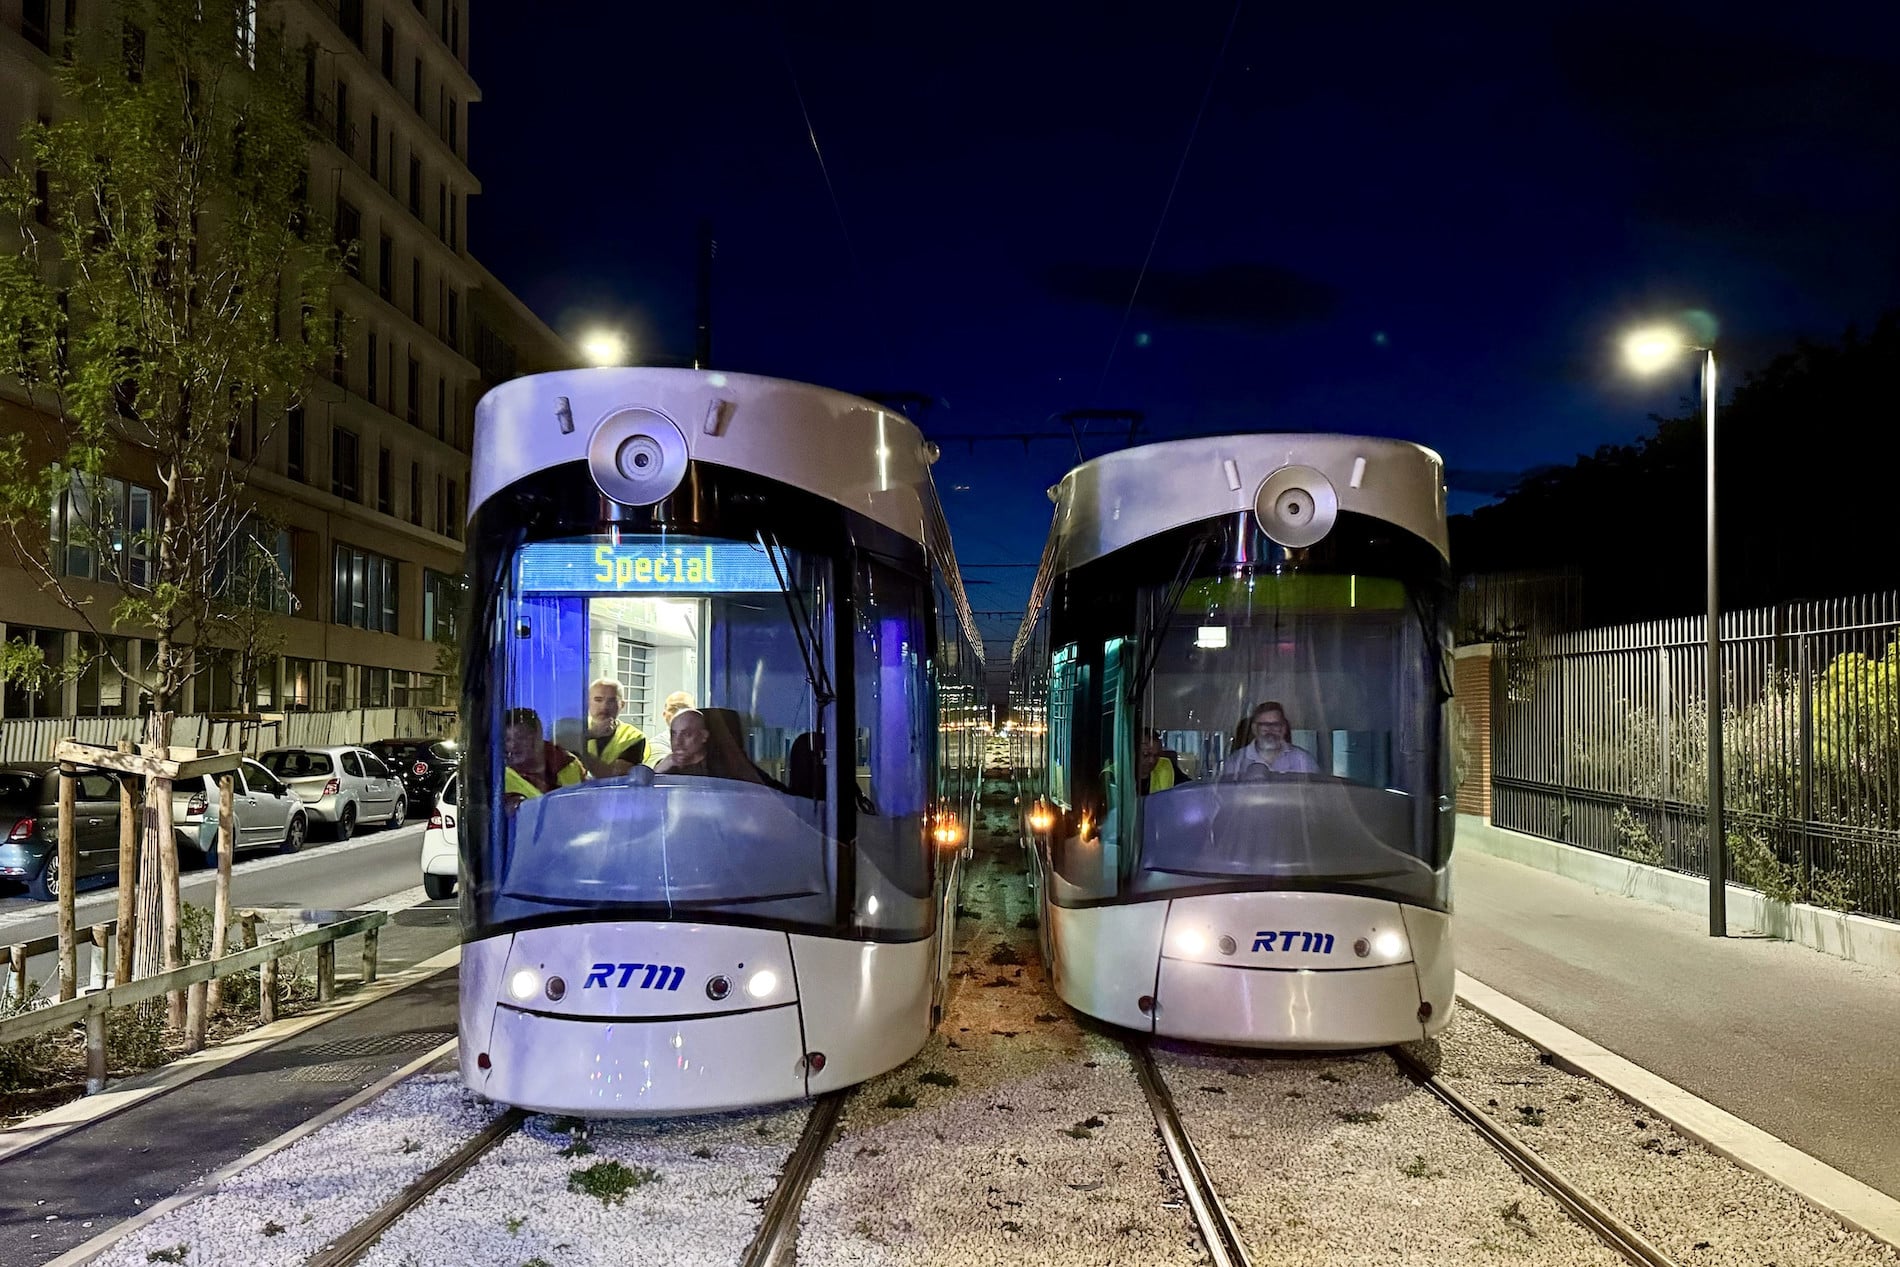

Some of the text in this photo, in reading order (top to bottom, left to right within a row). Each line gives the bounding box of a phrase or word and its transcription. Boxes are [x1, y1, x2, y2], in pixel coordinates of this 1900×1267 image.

[595, 546, 716, 588] Special
[1252, 931, 1334, 954] RTM
[583, 963, 685, 991] RTM
